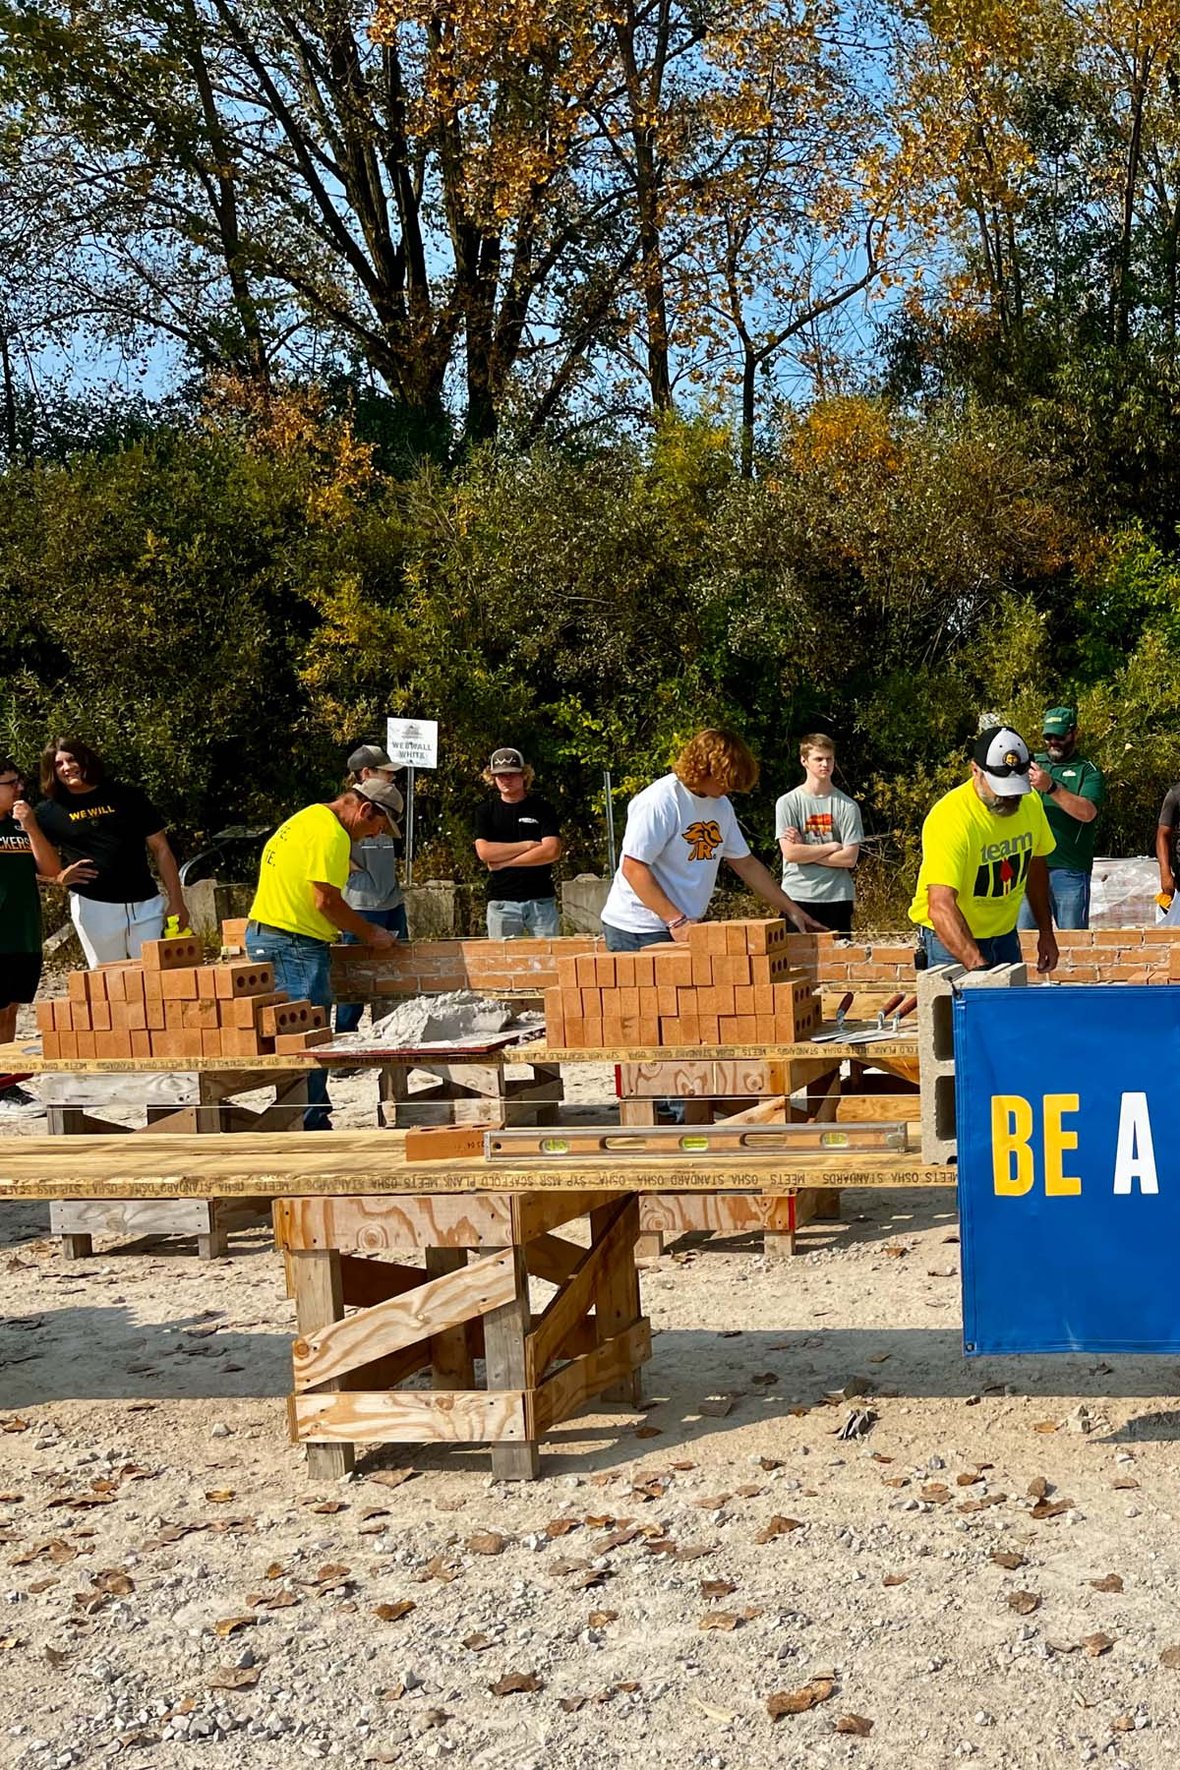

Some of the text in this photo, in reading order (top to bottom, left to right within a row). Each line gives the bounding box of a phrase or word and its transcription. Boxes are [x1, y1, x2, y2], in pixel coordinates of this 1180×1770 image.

[69, 805, 116, 821] WE WILL
[980, 831, 1033, 863] team
[990, 1093, 1082, 1198] BE
[1112, 1091, 1160, 1196] A
[404, 1177, 438, 1190] MEETS
[444, 1176, 476, 1188] PLANK
[480, 1176, 534, 1188] SCAFFOLD
[567, 1176, 587, 1188] SYP
[637, 1175, 664, 1186] OSHA
[670, 1174, 725, 1186] STANDARD
[731, 1174, 758, 1186] OSHA
[769, 1173, 806, 1185] MEETS
[822, 1173, 883, 1184] STANDARDS
[890, 1172, 919, 1183] OSHA
